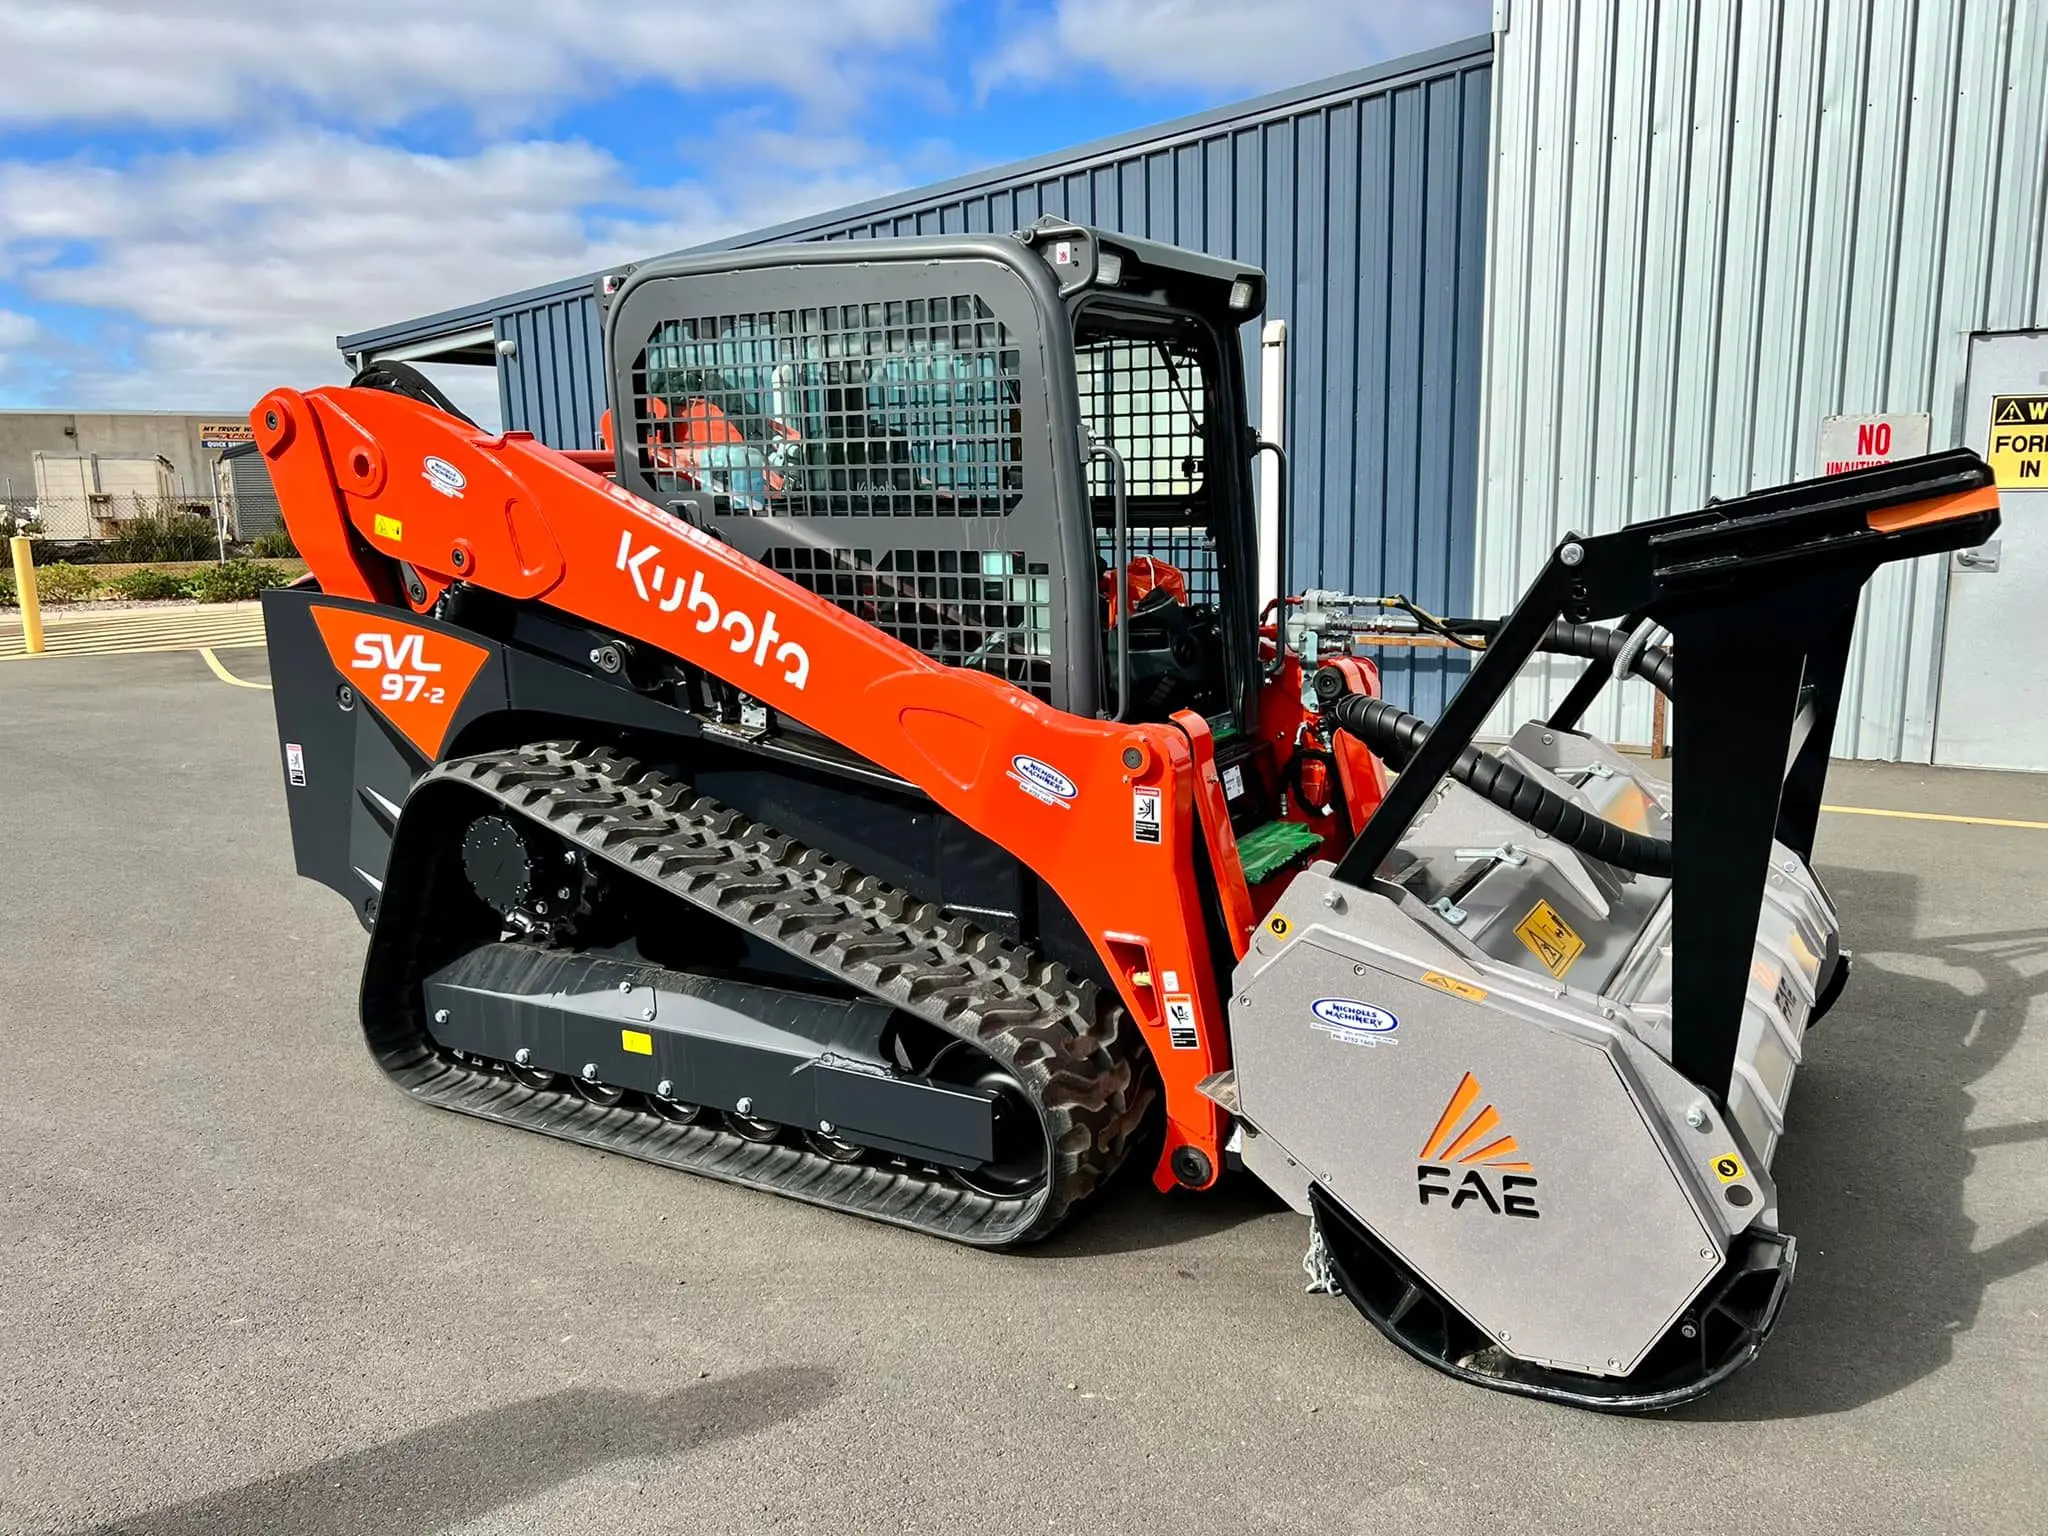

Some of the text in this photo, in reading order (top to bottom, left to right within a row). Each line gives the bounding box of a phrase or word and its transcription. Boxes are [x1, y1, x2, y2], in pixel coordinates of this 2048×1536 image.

[1857, 422, 1891, 456] NO
[1995, 435, 2048, 454] FOR
[2020, 460, 2041, 478] IN
[615, 529, 810, 691] Kubota
[351, 633, 442, 672] SVL
[380, 673, 445, 704] 97-2
[1022, 765, 1066, 792] MACHINERY
[1030, 762, 1064, 785] NICHOLLS
[1325, 1009, 1384, 1028] MACHINERY
[1332, 1002, 1377, 1018] NICHOLLS
[1417, 1165, 1540, 1219] FAE
